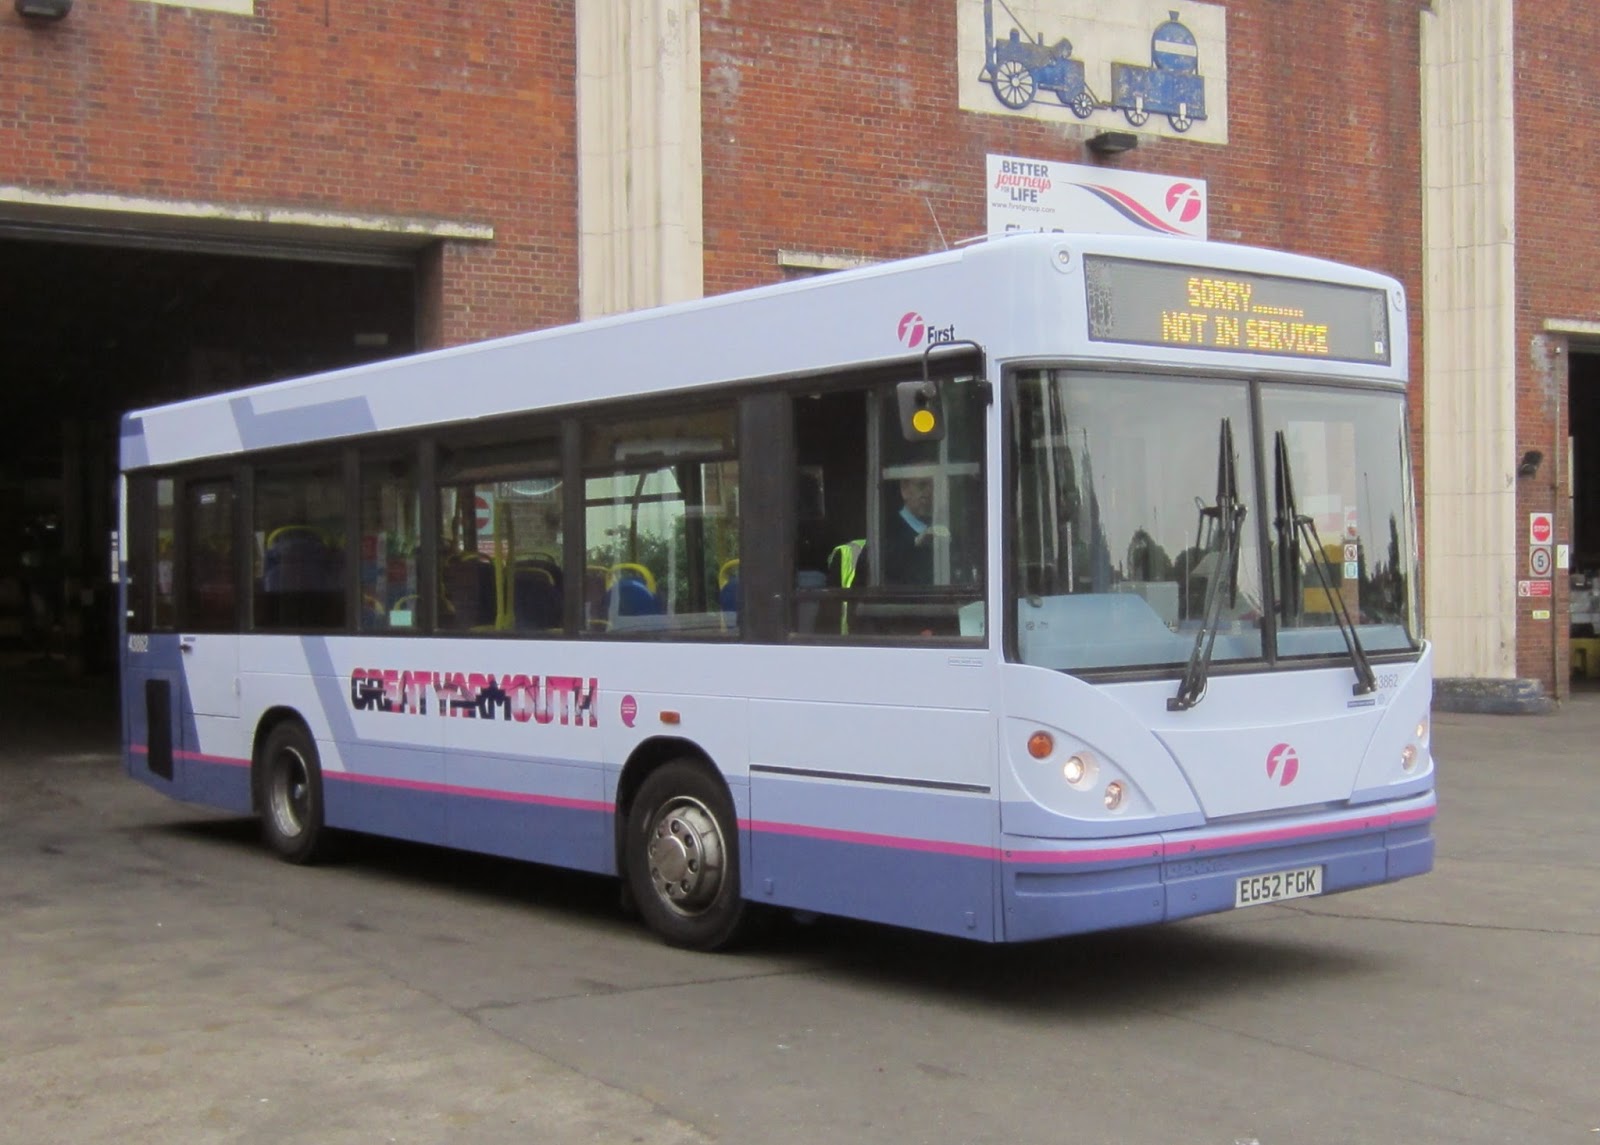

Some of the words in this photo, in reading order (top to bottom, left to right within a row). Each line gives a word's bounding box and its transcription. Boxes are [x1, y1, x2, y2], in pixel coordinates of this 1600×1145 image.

[1002, 160, 1049, 178] BETTER
[994, 170, 1052, 193] journeys
[1011, 187, 1038, 204] LIFE
[992, 202, 1056, 213] www.firstgroup.com
[927, 324, 955, 344] First
[1161, 311, 1208, 343] NOT
[1214, 316, 1240, 346] IN
[1246, 318, 1329, 353] SERVICE
[1537, 555, 1544, 568] 5
[1376, 673, 1399, 689] 3862
[1240, 874, 1281, 903] EG52
[1285, 870, 1316, 895] FGK
